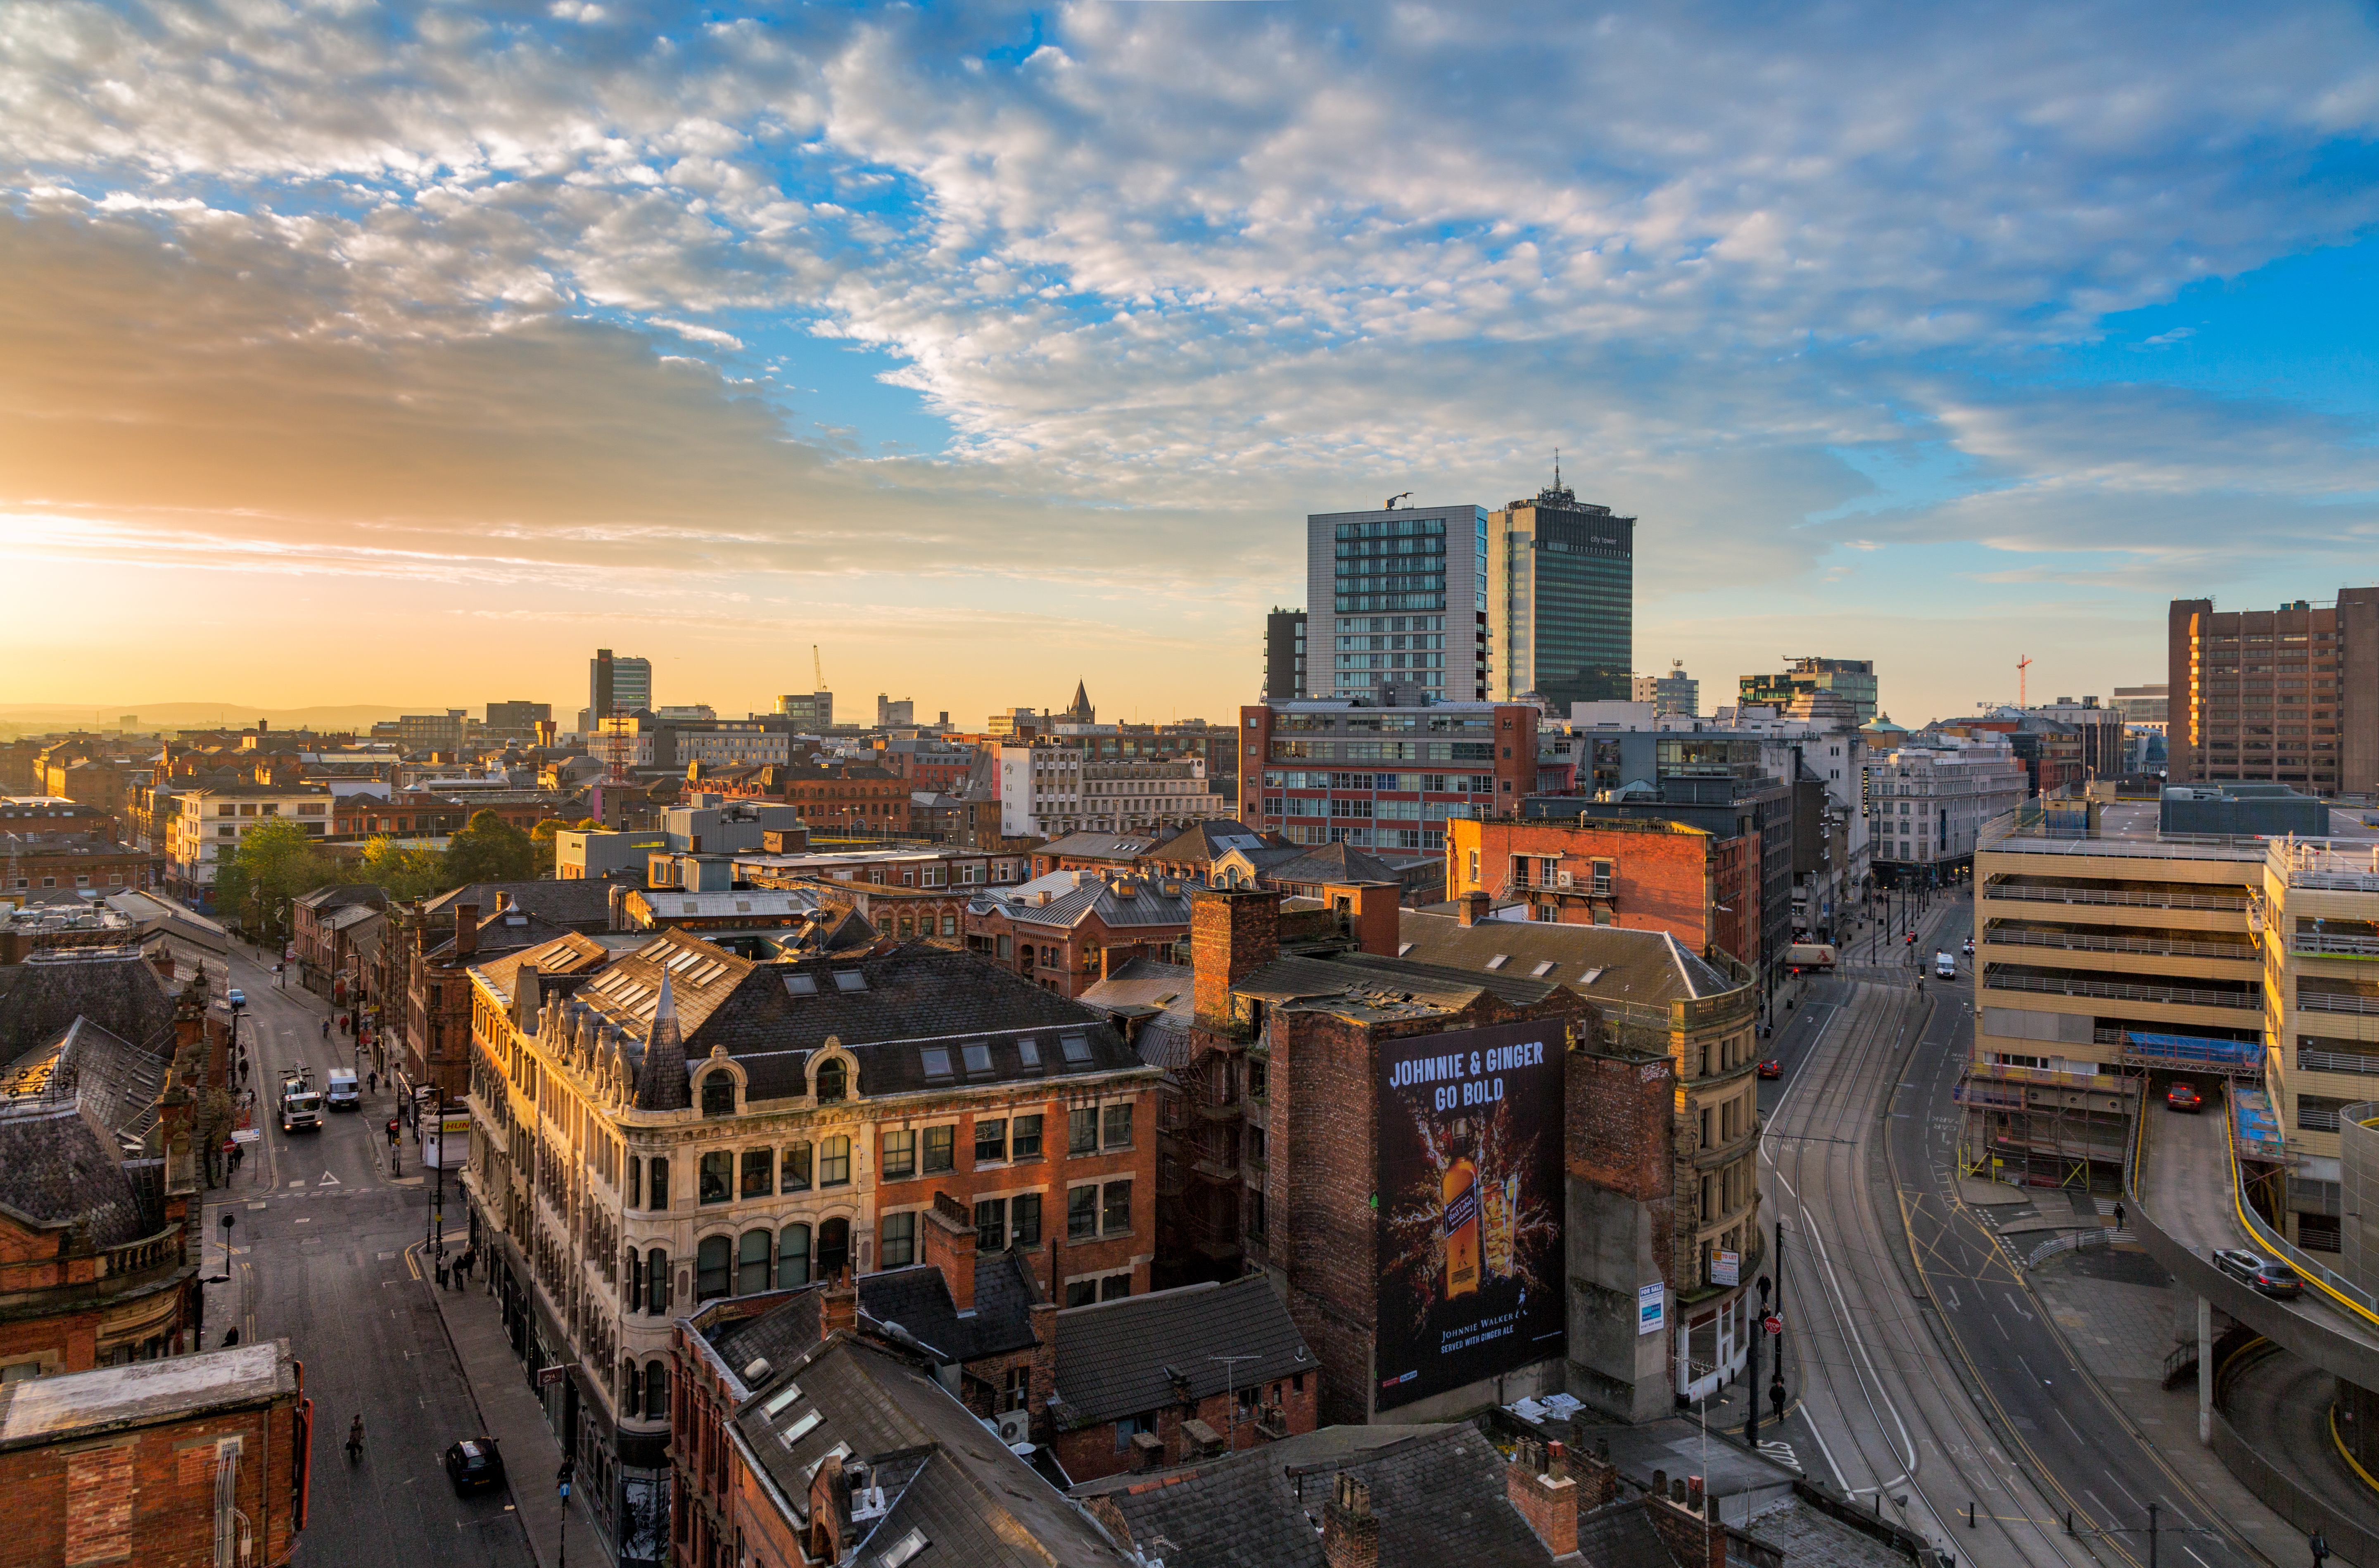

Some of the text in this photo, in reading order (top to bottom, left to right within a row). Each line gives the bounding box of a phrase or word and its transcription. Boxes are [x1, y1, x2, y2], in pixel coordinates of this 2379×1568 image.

[1591, 535, 1617, 545] city tower
[1389, 1041, 1543, 1089] JOHNNIE & GINGER
[1435, 1078, 1503, 1112] GO BOLD
[1448, 1210, 1459, 1222] Red
[1459, 1197, 1474, 1214] Label
[1441, 1313, 1513, 1343] JOHNNIE WALKER
[1441, 1325, 1514, 1354] SERVED WITH GINGER ALE
